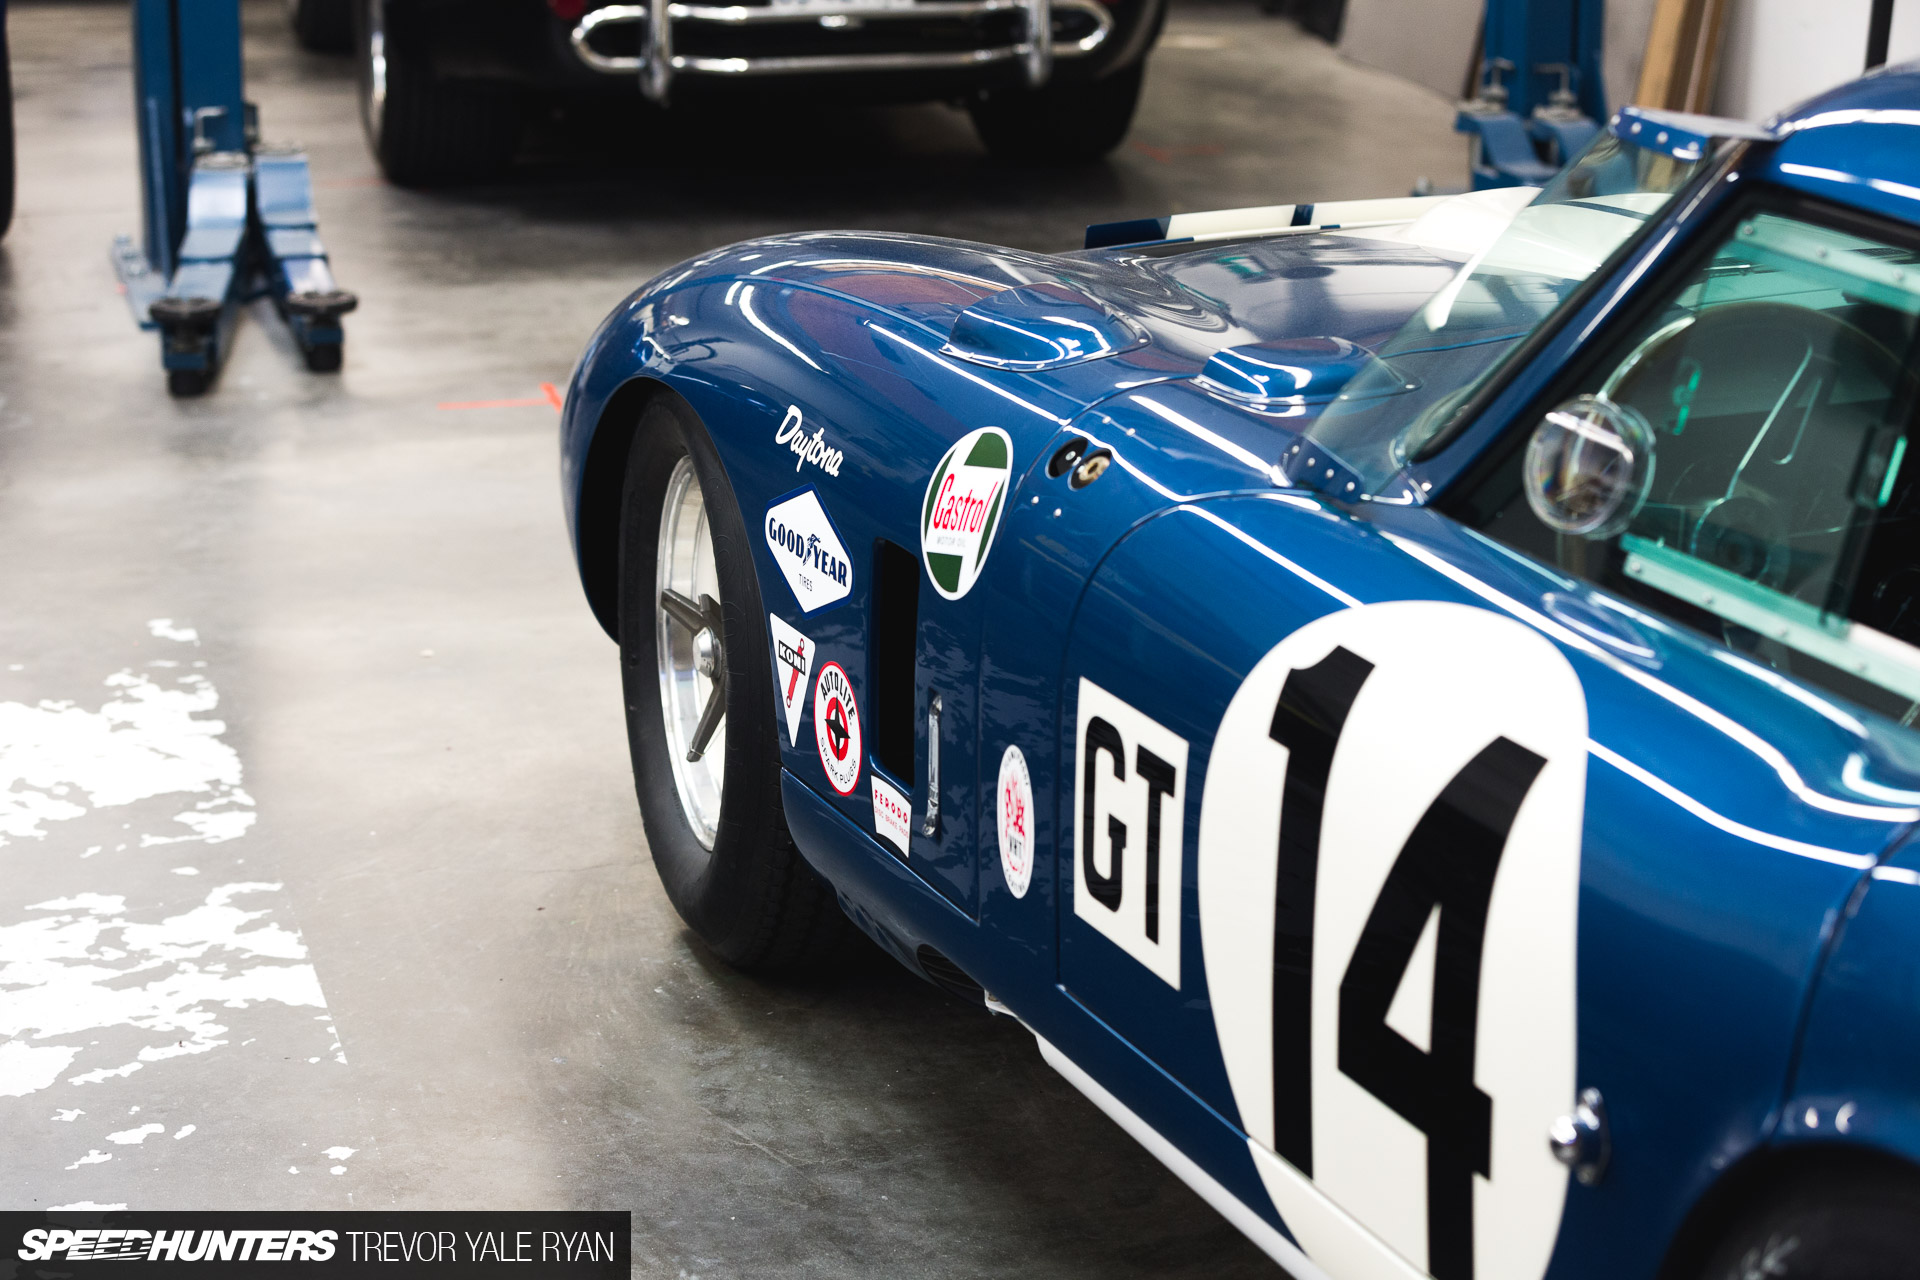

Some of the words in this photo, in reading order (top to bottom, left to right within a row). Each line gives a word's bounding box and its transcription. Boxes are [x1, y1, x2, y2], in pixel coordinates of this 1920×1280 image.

[775, 404, 843, 477] Daytona
[933, 473, 998, 533] Castrol
[798, 573, 813, 592] TIRES
[779, 643, 805, 672] KONI
[821, 737, 839, 781] SPARK
[840, 759, 857, 784] PLUGS
[874, 789, 908, 824] FERODO
[1083, 715, 1177, 946] GT
[1268, 645, 1549, 1280] 14
